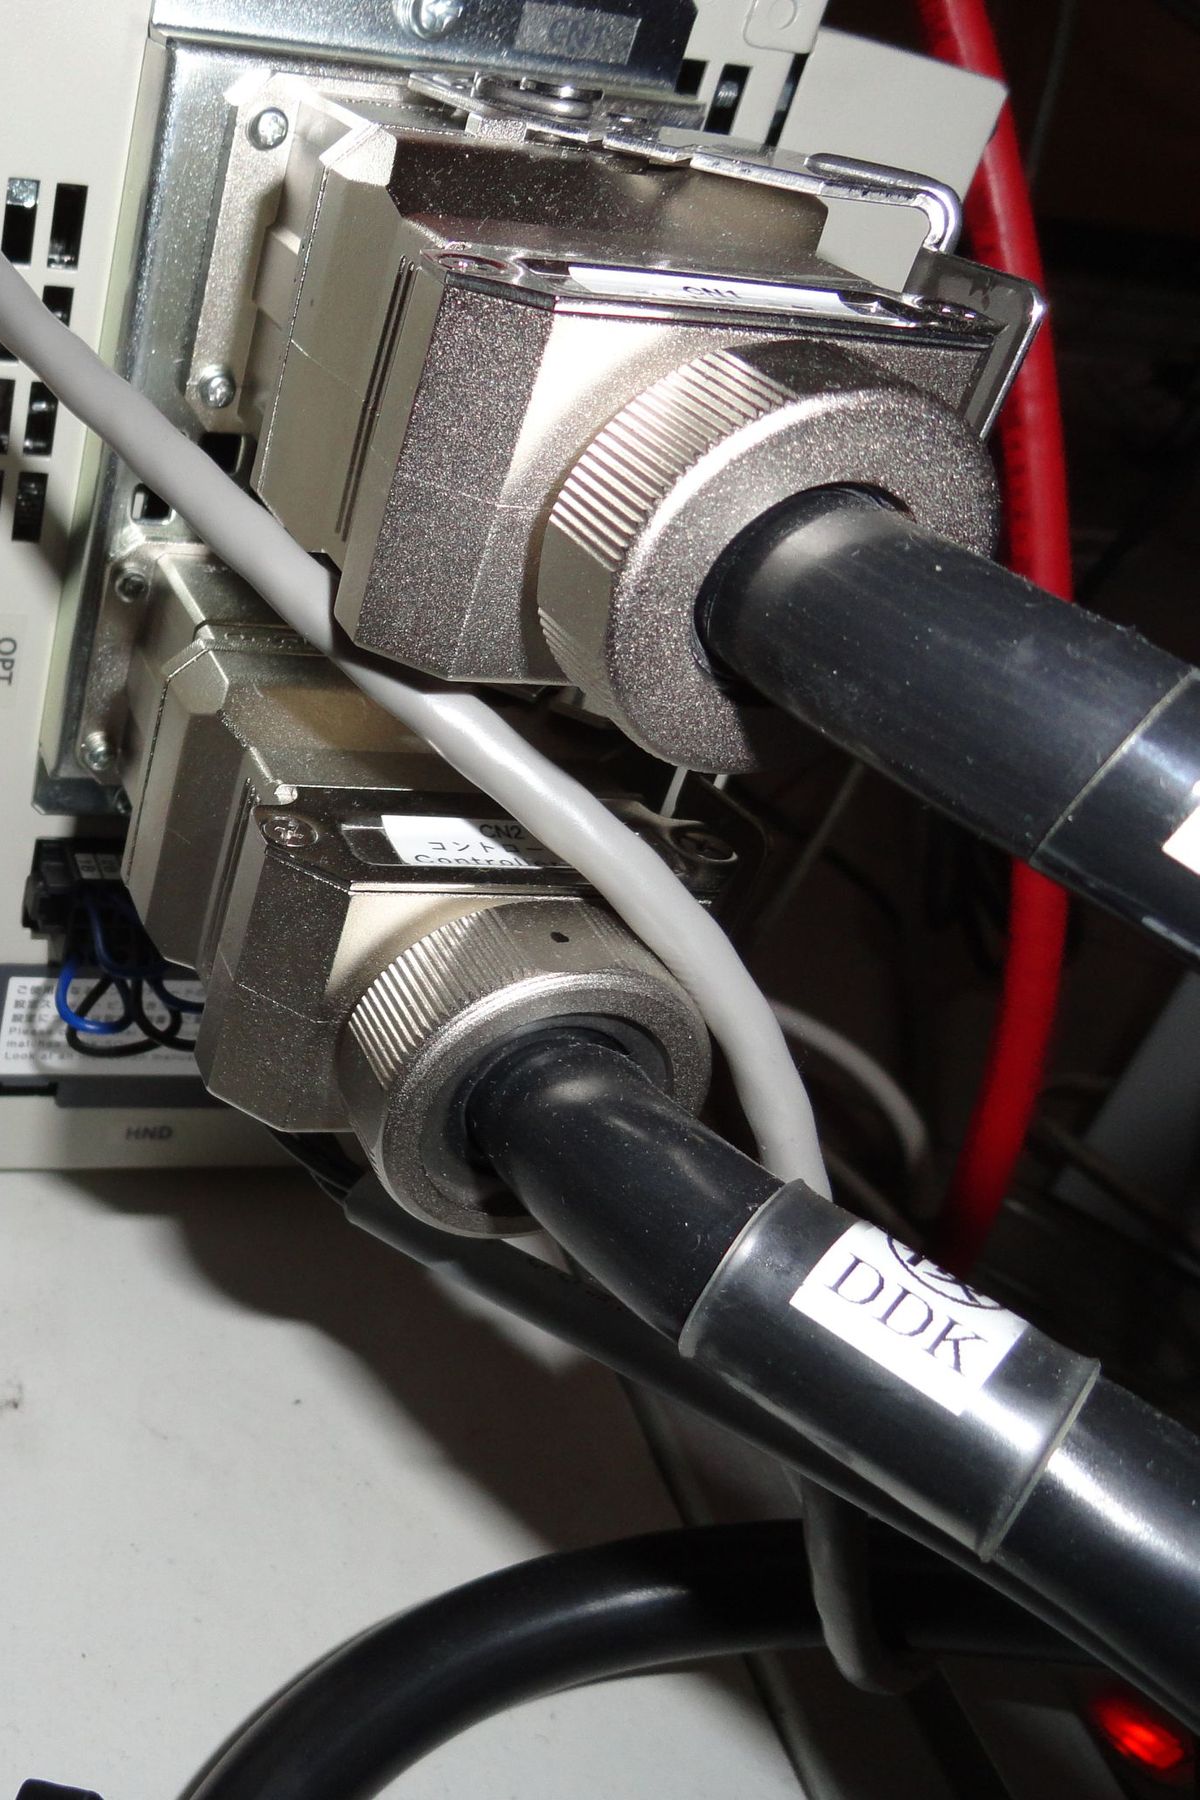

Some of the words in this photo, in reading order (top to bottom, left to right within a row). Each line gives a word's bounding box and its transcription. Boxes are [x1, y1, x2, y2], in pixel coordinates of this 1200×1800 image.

[478, 823, 526, 840] CN2
[427, 841, 544, 854] コントロー
[126, 1125, 174, 1139] HND
[823, 1251, 990, 1377] DDK
